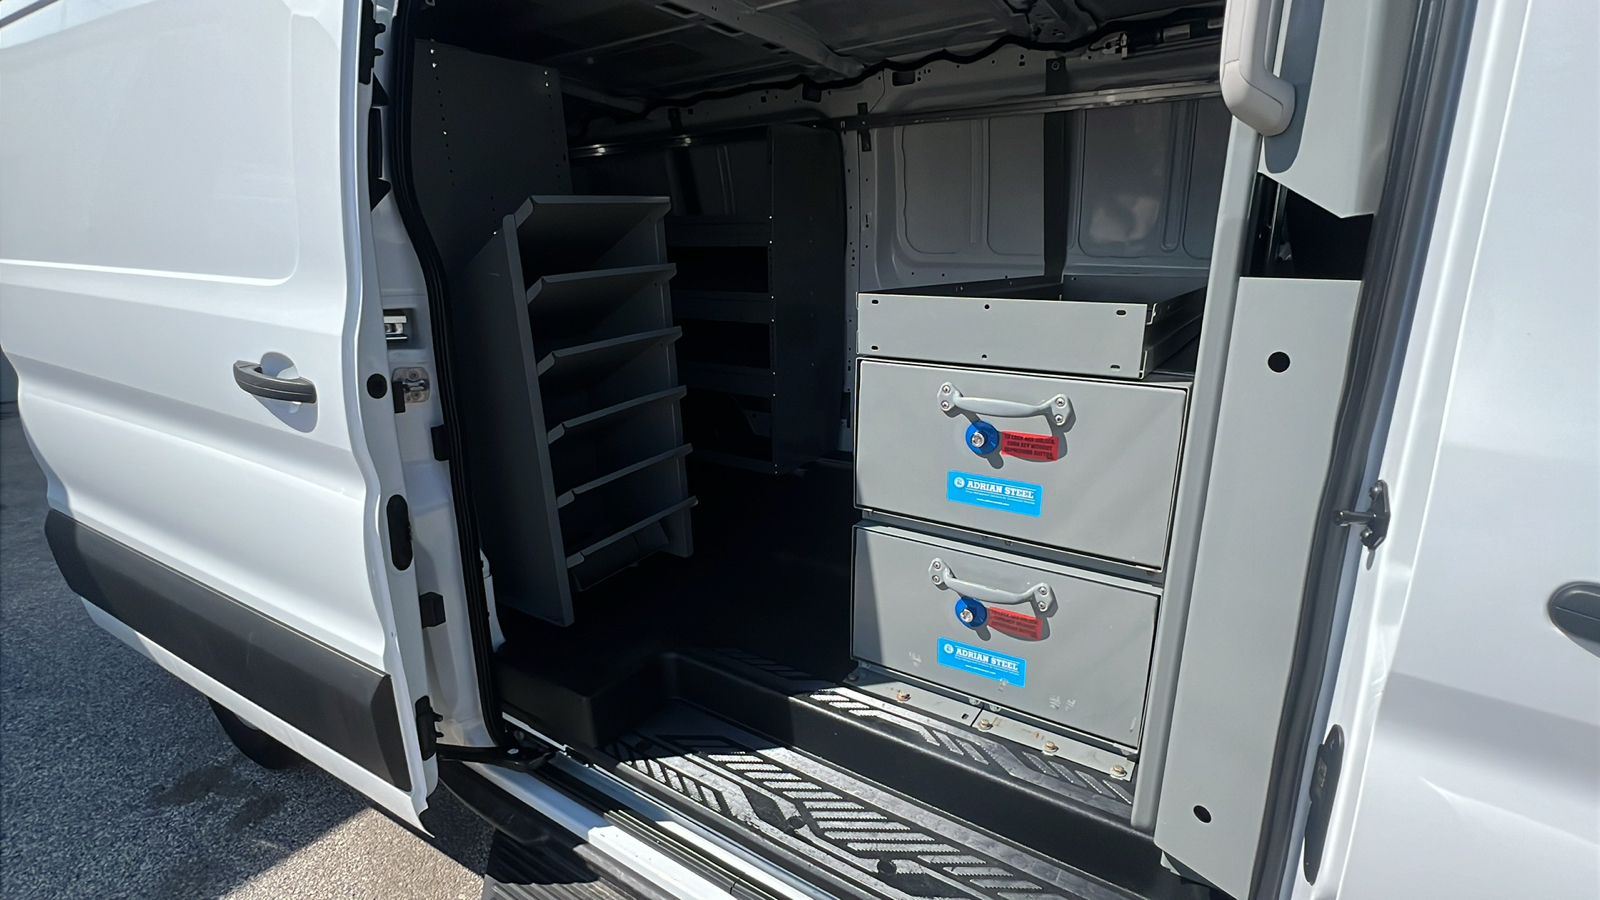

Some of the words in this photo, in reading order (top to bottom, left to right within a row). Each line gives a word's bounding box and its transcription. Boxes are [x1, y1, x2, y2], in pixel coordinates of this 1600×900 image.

[967, 481, 1003, 493] ADRIAN
[1004, 487, 1034, 499] STEEL
[956, 648, 989, 663] ADRIAN
[990, 657, 1018, 671] STEEL
